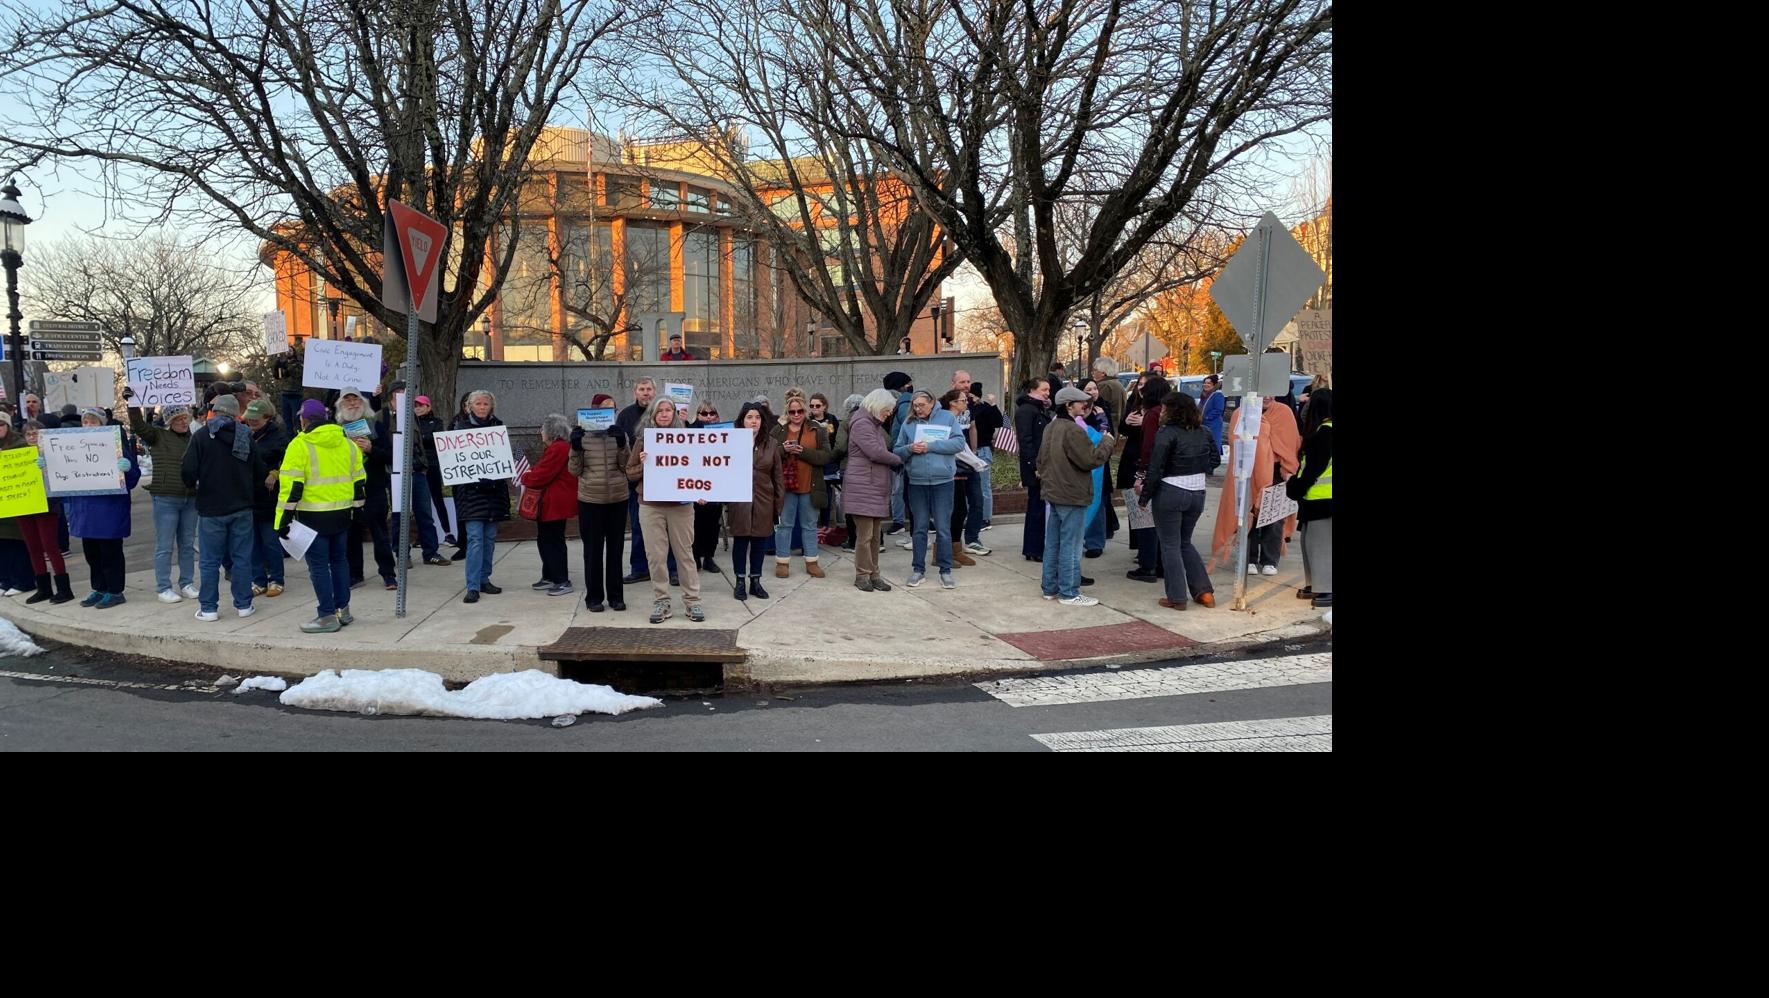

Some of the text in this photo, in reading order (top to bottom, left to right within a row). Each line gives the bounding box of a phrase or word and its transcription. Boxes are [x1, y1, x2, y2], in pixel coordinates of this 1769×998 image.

[412, 236, 428, 252] YIELD
[126, 358, 192, 382] Freedom
[314, 371, 329, 381] Not
[149, 380, 179, 390] Needs
[500, 379, 514, 390] TO
[521, 380, 580, 390] REMEMBER
[586, 379, 610, 389] AND
[700, 377, 759, 388] AMERICANS
[766, 376, 790, 386] WHO
[795, 375, 823, 386] GAVE
[829, 375, 843, 384] OF
[132, 385, 192, 405] Voices
[694, 390, 741, 400] VIETNAM
[747, 390, 768, 398] WAR
[49, 437, 76, 453] Free
[435, 430, 506, 453] DIVERSITY
[656, 432, 728, 444] PROTECT
[85, 453, 99, 463] NO
[455, 449, 495, 463] IS OUR
[655, 455, 731, 467] KIDS NOT
[443, 460, 513, 480] STRENGTH
[677, 478, 712, 491] EGOS
